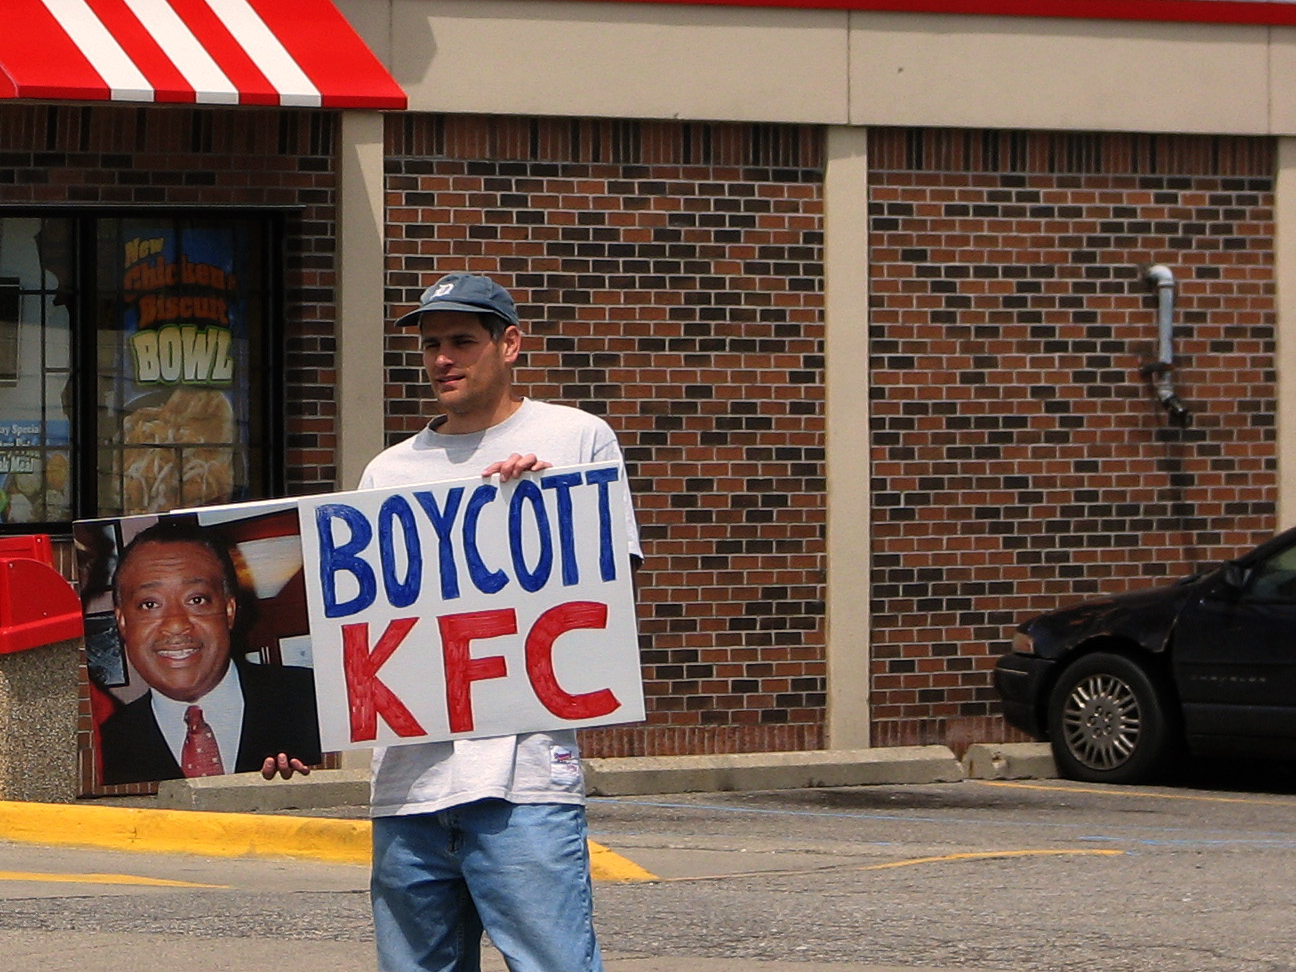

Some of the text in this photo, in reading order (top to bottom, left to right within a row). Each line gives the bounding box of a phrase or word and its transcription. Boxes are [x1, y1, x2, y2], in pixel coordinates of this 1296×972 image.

[125, 237, 165, 269] New
[132, 325, 234, 383] BOWL
[315, 466, 619, 618] BOYCOTT
[341, 600, 622, 743] KFC
